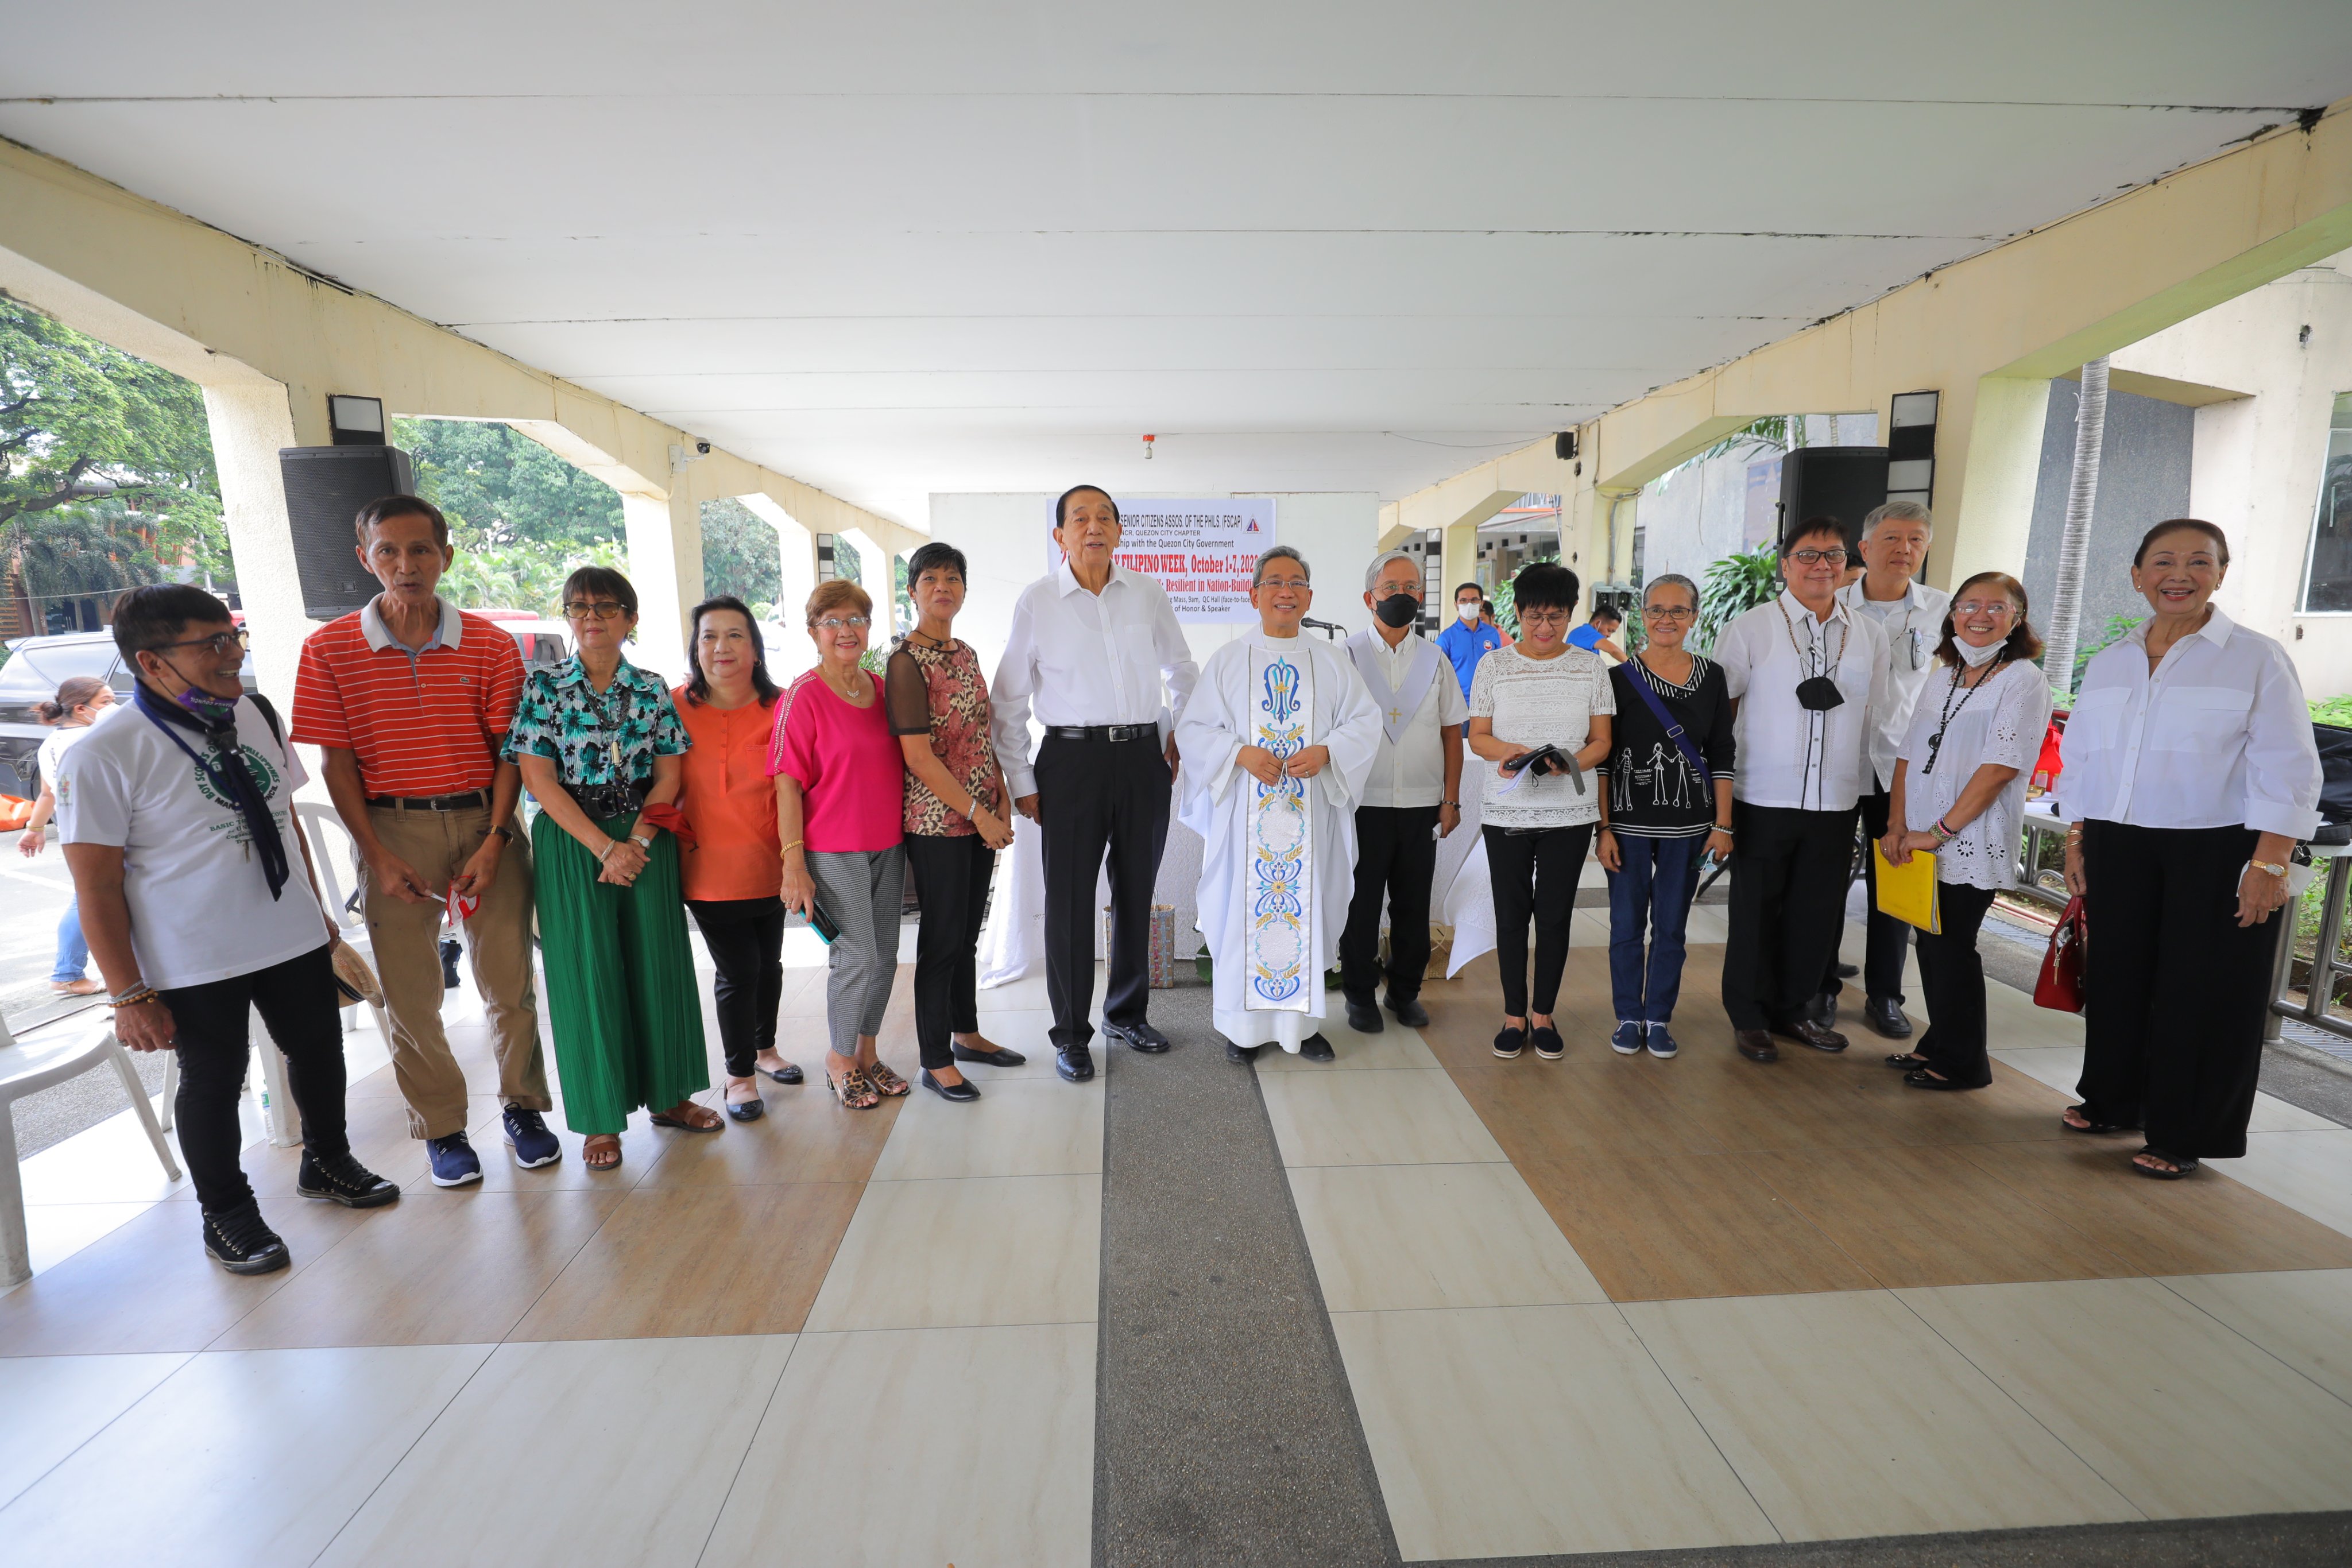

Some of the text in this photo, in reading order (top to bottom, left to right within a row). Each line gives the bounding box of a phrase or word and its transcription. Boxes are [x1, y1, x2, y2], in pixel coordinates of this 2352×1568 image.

[1120, 514, 1243, 531] SENIOR CITIZENS ASSOS. OF THE PHILS. (FSCAP)
[1131, 539, 1145, 548] with
[1147, 539, 1156, 548] the
[1158, 539, 1181, 548] Quezon
[1183, 539, 1194, 549] City
[1196, 539, 1234, 548] Government
[1121, 554, 1159, 573] FILIPINO
[1160, 554, 1187, 578] WEEK,
[1191, 554, 1224, 573] October
[1166, 579, 1196, 592] Resilient
[1198, 579, 1205, 592] in
[1208, 605, 1231, 613] Speaker
[194, 752, 210, 782] SCOS
[241, 744, 281, 783] PHILIPPINES
[198, 783, 215, 800] BOY
[210, 821, 234, 831] BASIC
